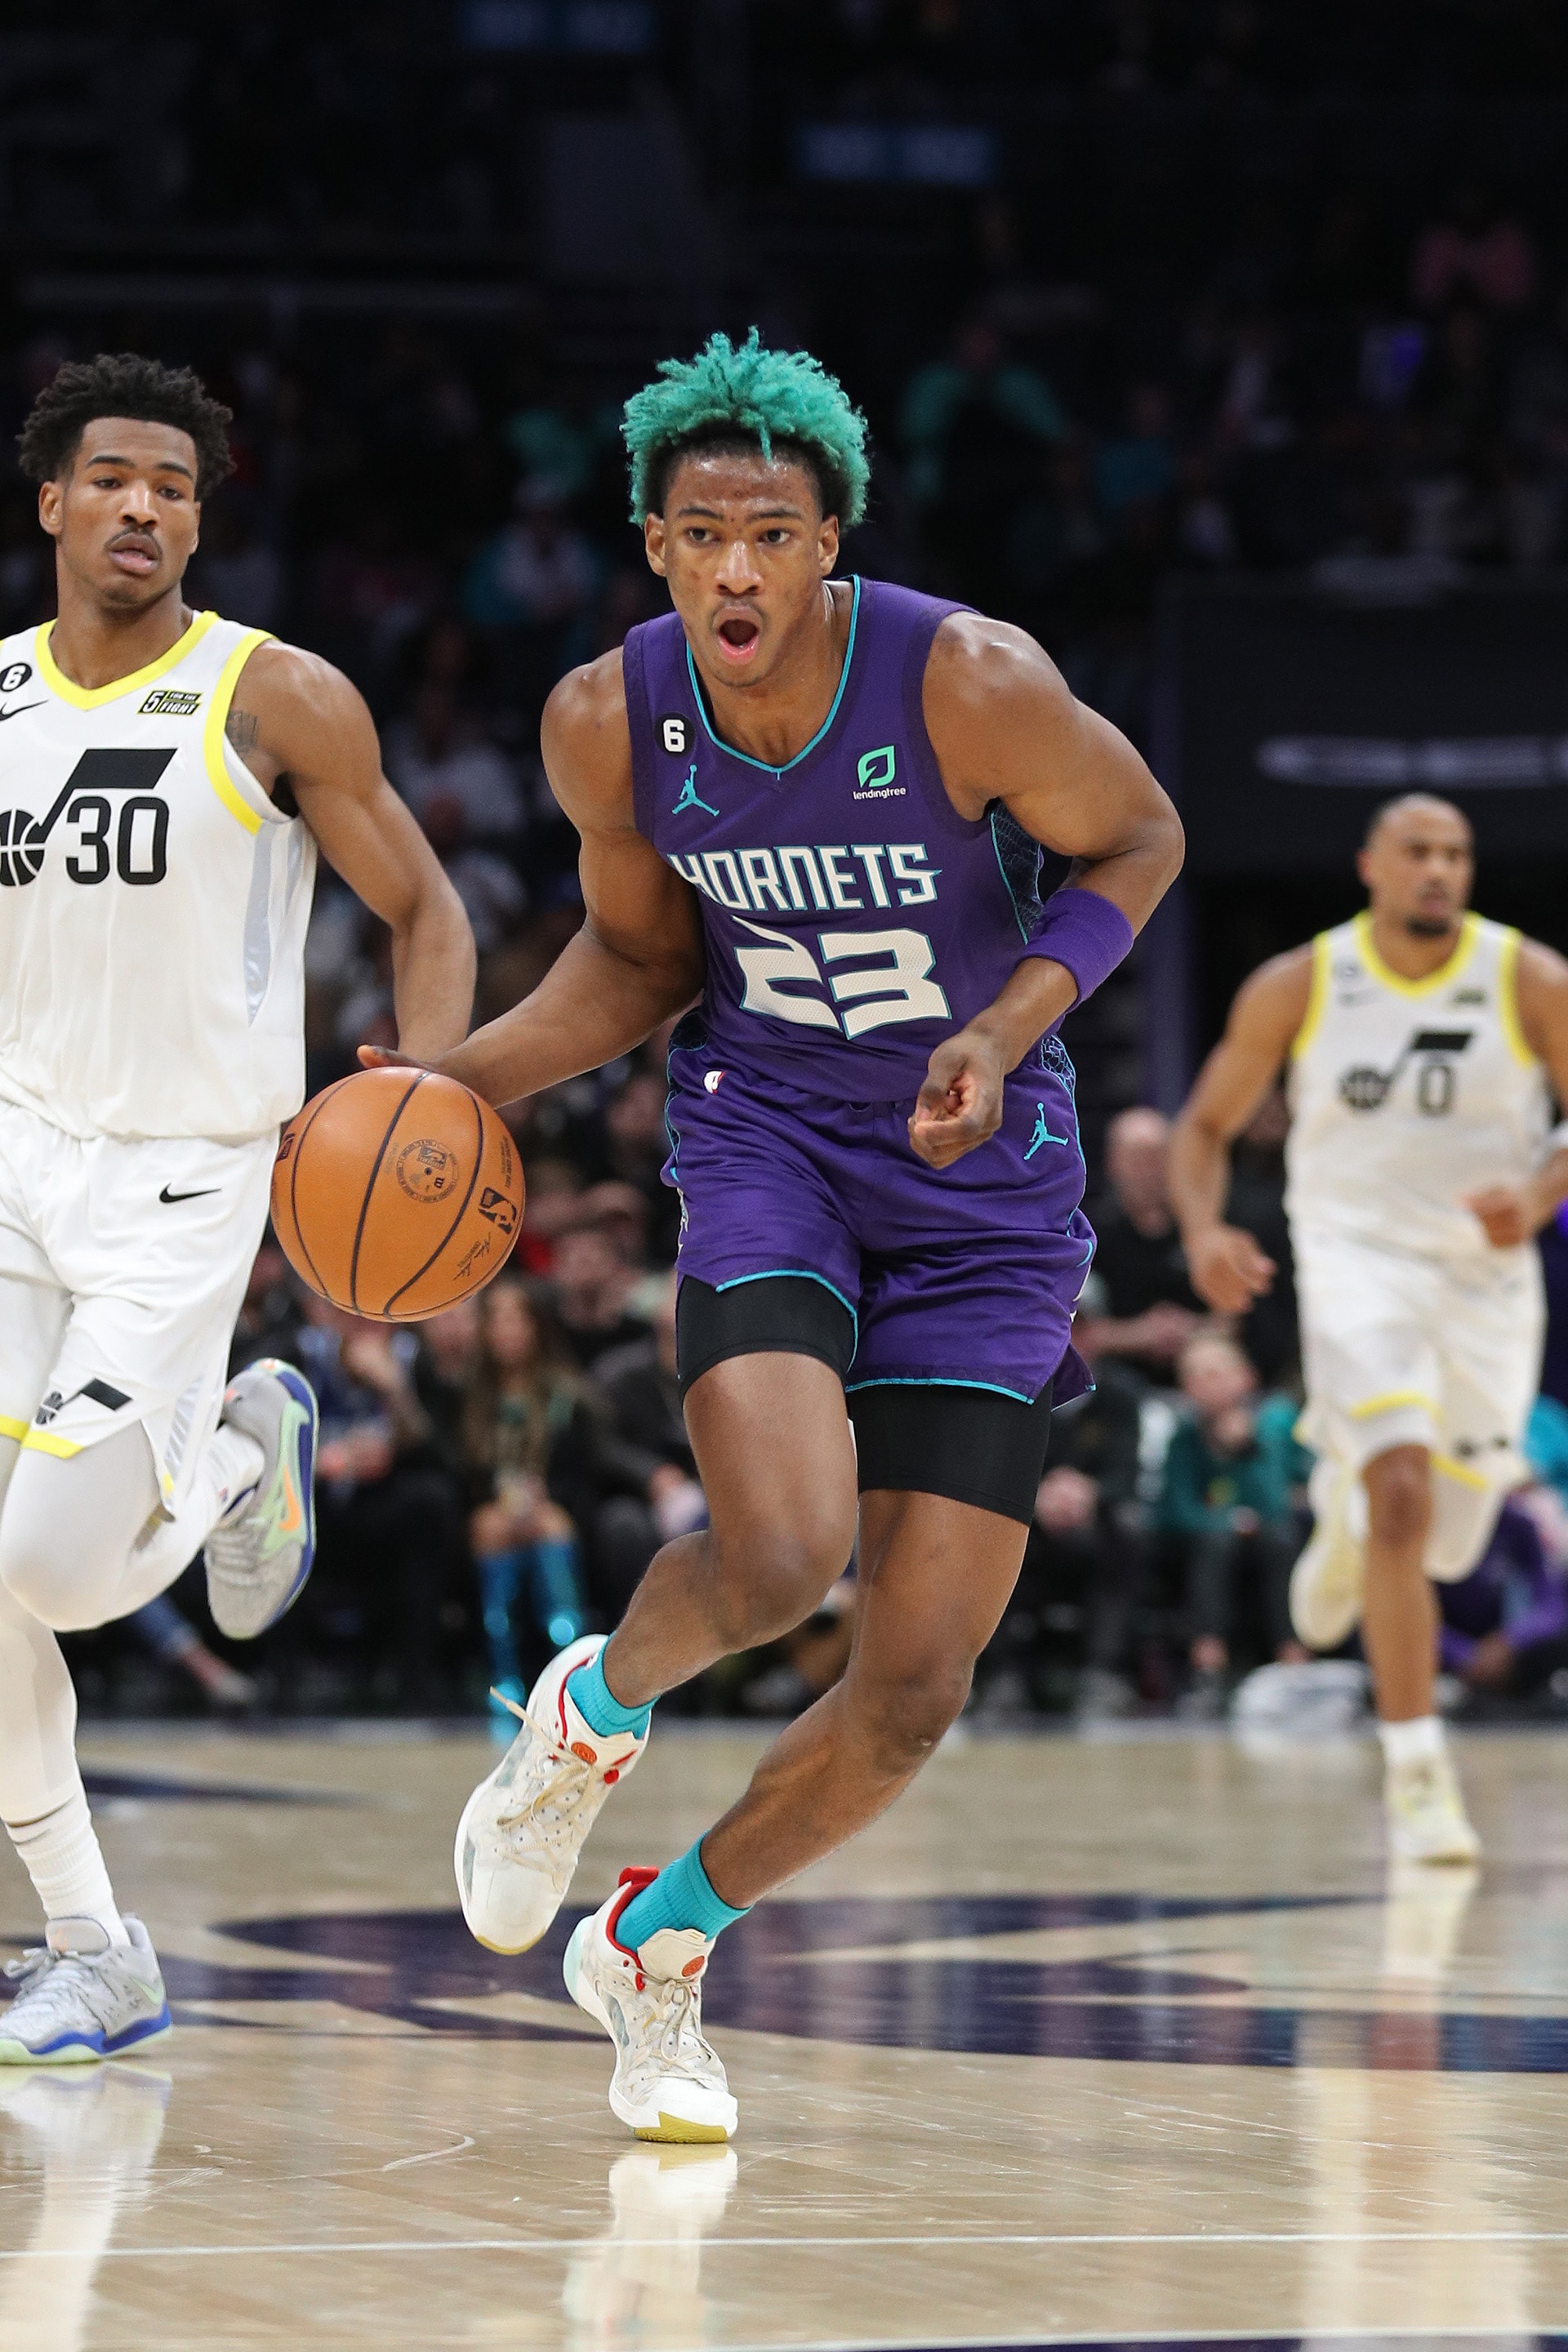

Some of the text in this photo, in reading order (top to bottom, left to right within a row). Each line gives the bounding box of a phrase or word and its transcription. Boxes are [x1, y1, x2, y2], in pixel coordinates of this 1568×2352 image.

[1, 670, 23, 688] 6
[142, 692, 165, 713] 5
[662, 719, 685, 753] 6
[853, 787, 906, 800] lendingtree
[66, 795, 170, 886] 30
[667, 843, 942, 912] HORNETS
[731, 915, 953, 1040] 23
[1417, 1063, 1456, 1118] 0
